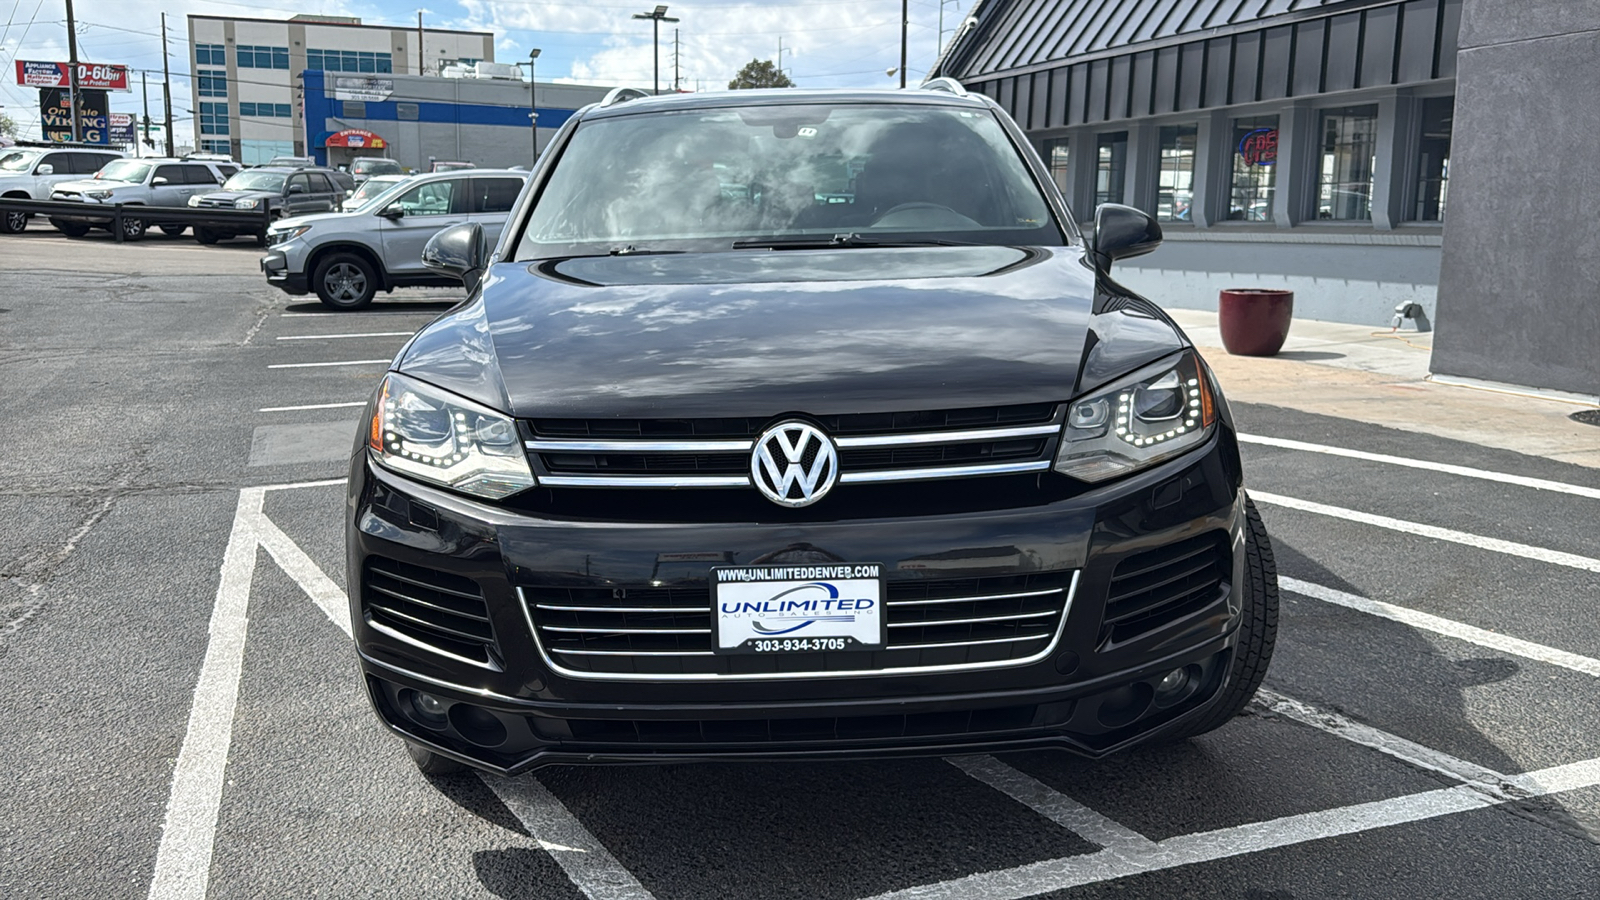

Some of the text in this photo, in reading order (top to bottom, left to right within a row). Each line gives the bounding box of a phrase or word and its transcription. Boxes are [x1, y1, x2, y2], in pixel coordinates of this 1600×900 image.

[25, 62, 56, 70] APPLIANCE
[78, 65, 109, 80] 0-60
[47, 107, 98, 116] On ale
[42, 114, 107, 128] VIKNG
[1244, 130, 1279, 166] OPE
[717, 566, 879, 581] WWWUNLIMITEDDENVER.COM
[721, 598, 875, 613] UNLIMITED
[755, 638, 845, 651] 303-934-3705
